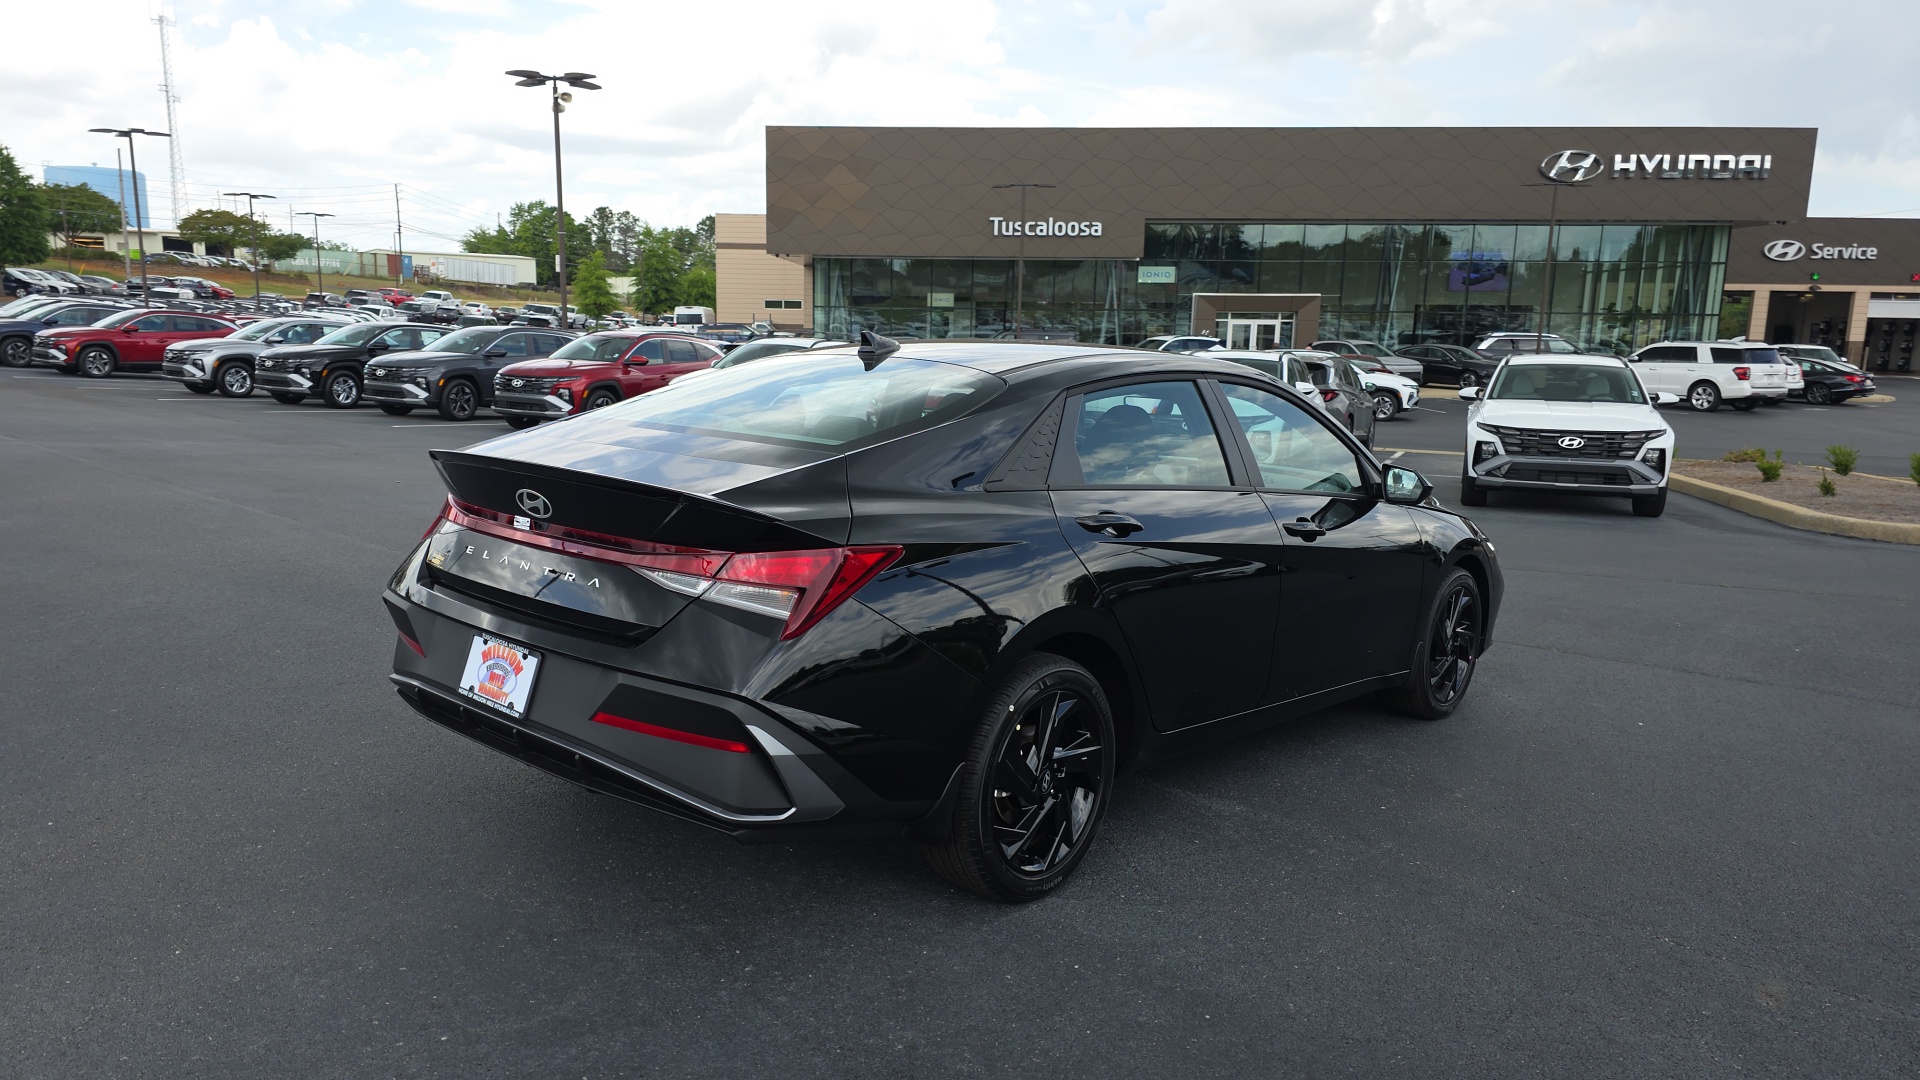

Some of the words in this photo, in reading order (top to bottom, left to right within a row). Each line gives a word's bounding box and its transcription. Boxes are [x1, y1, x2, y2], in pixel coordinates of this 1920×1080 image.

[1612, 154, 1772, 179] HYUNDAI
[989, 216, 1103, 236] Tuscaloosa
[1810, 243, 1878, 260] Service
[465, 545, 600, 589] ELANTRA
[481, 643, 524, 678] MILLION
[488, 670, 506, 689] MILE
